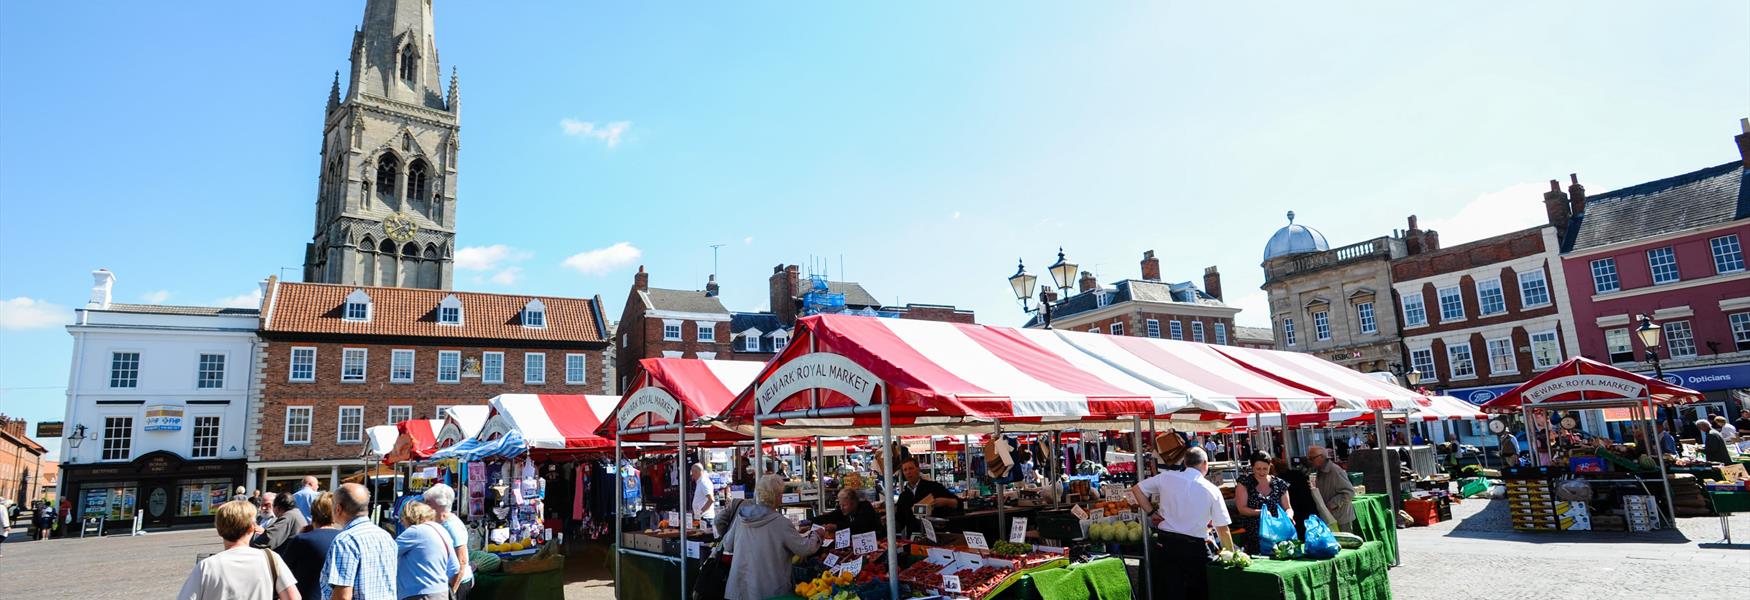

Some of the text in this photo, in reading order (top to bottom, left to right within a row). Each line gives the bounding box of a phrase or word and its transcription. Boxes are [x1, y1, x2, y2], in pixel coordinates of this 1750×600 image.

[1331, 352, 1351, 361] HSBC
[761, 363, 870, 405] NEWARK ROYAL MARKET
[1530, 379, 1637, 400] NEWARK ROYAL MARKET
[1688, 374, 1732, 384] Opticians
[639, 393, 654, 407] ROYAL
[654, 395, 675, 417] MARKET
